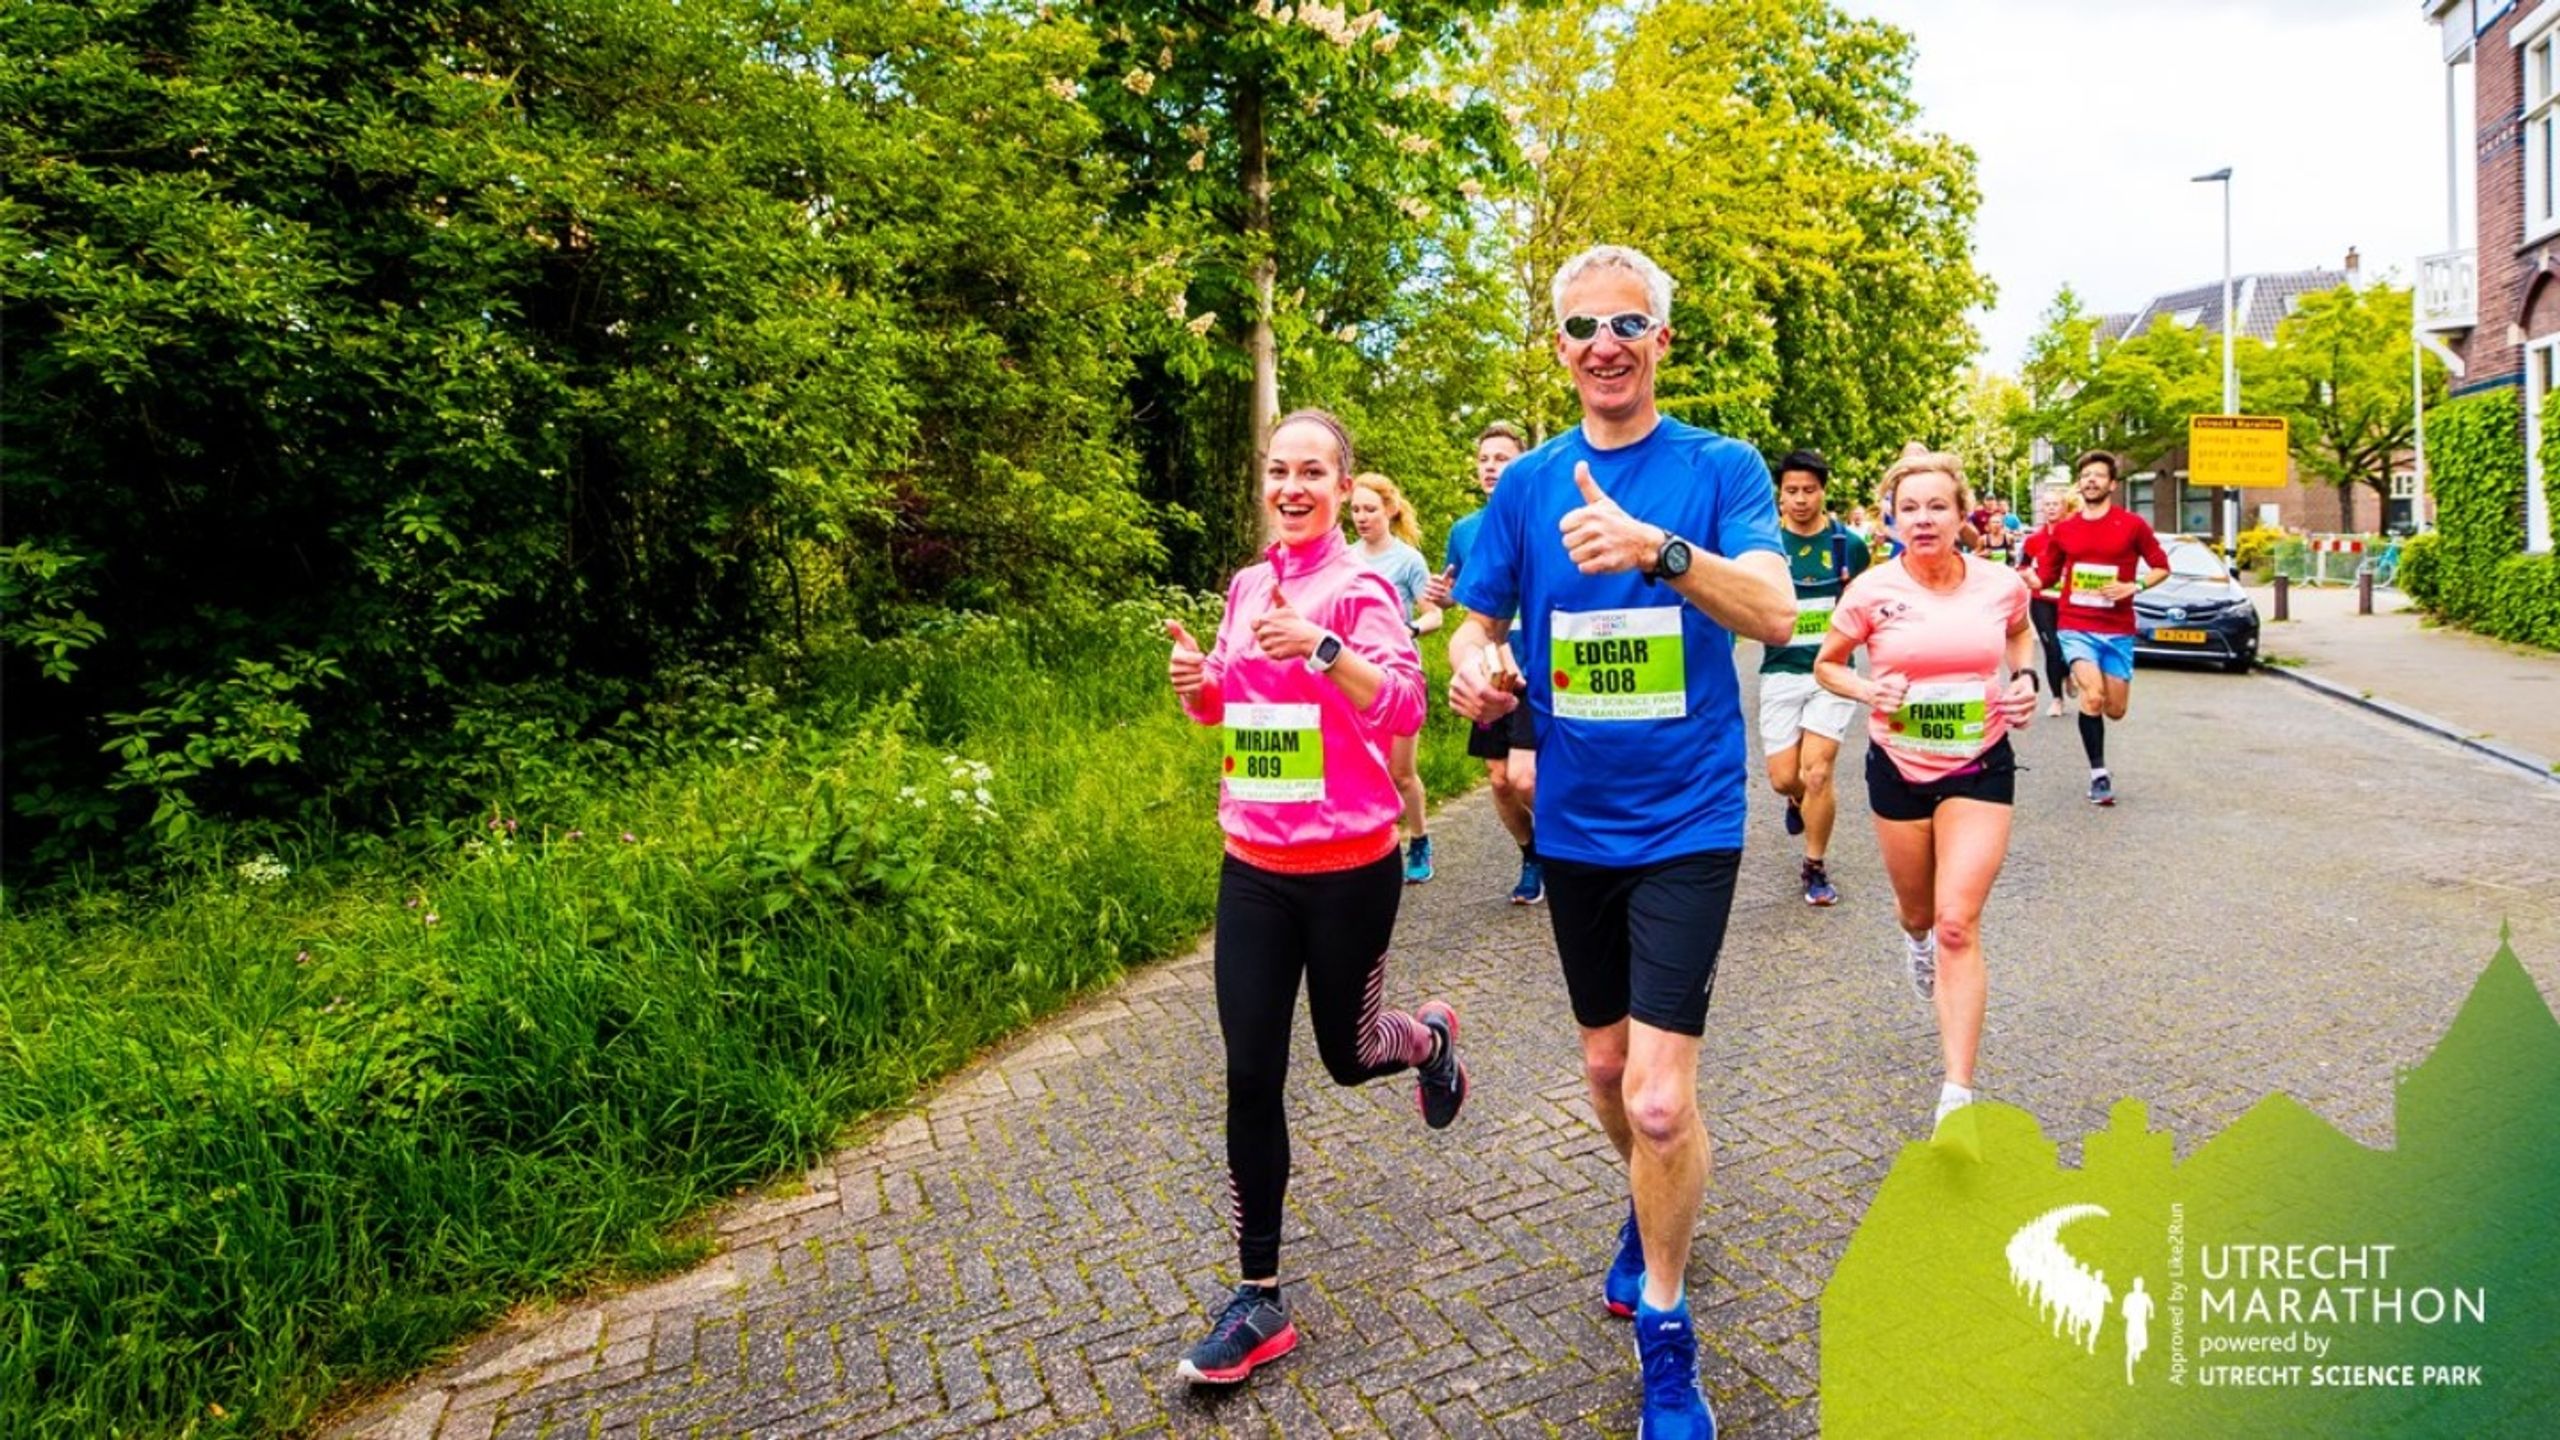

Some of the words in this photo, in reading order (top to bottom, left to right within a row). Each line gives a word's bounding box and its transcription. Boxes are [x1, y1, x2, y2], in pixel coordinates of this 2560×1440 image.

[1574, 640, 1648, 665] EDGAR
[1590, 668, 1636, 694] 808
[1909, 703, 1966, 721] FIANNE
[1235, 729, 1300, 753] MIRJAM
[1921, 723, 1956, 740] 605
[1247, 755, 1282, 778] 809
